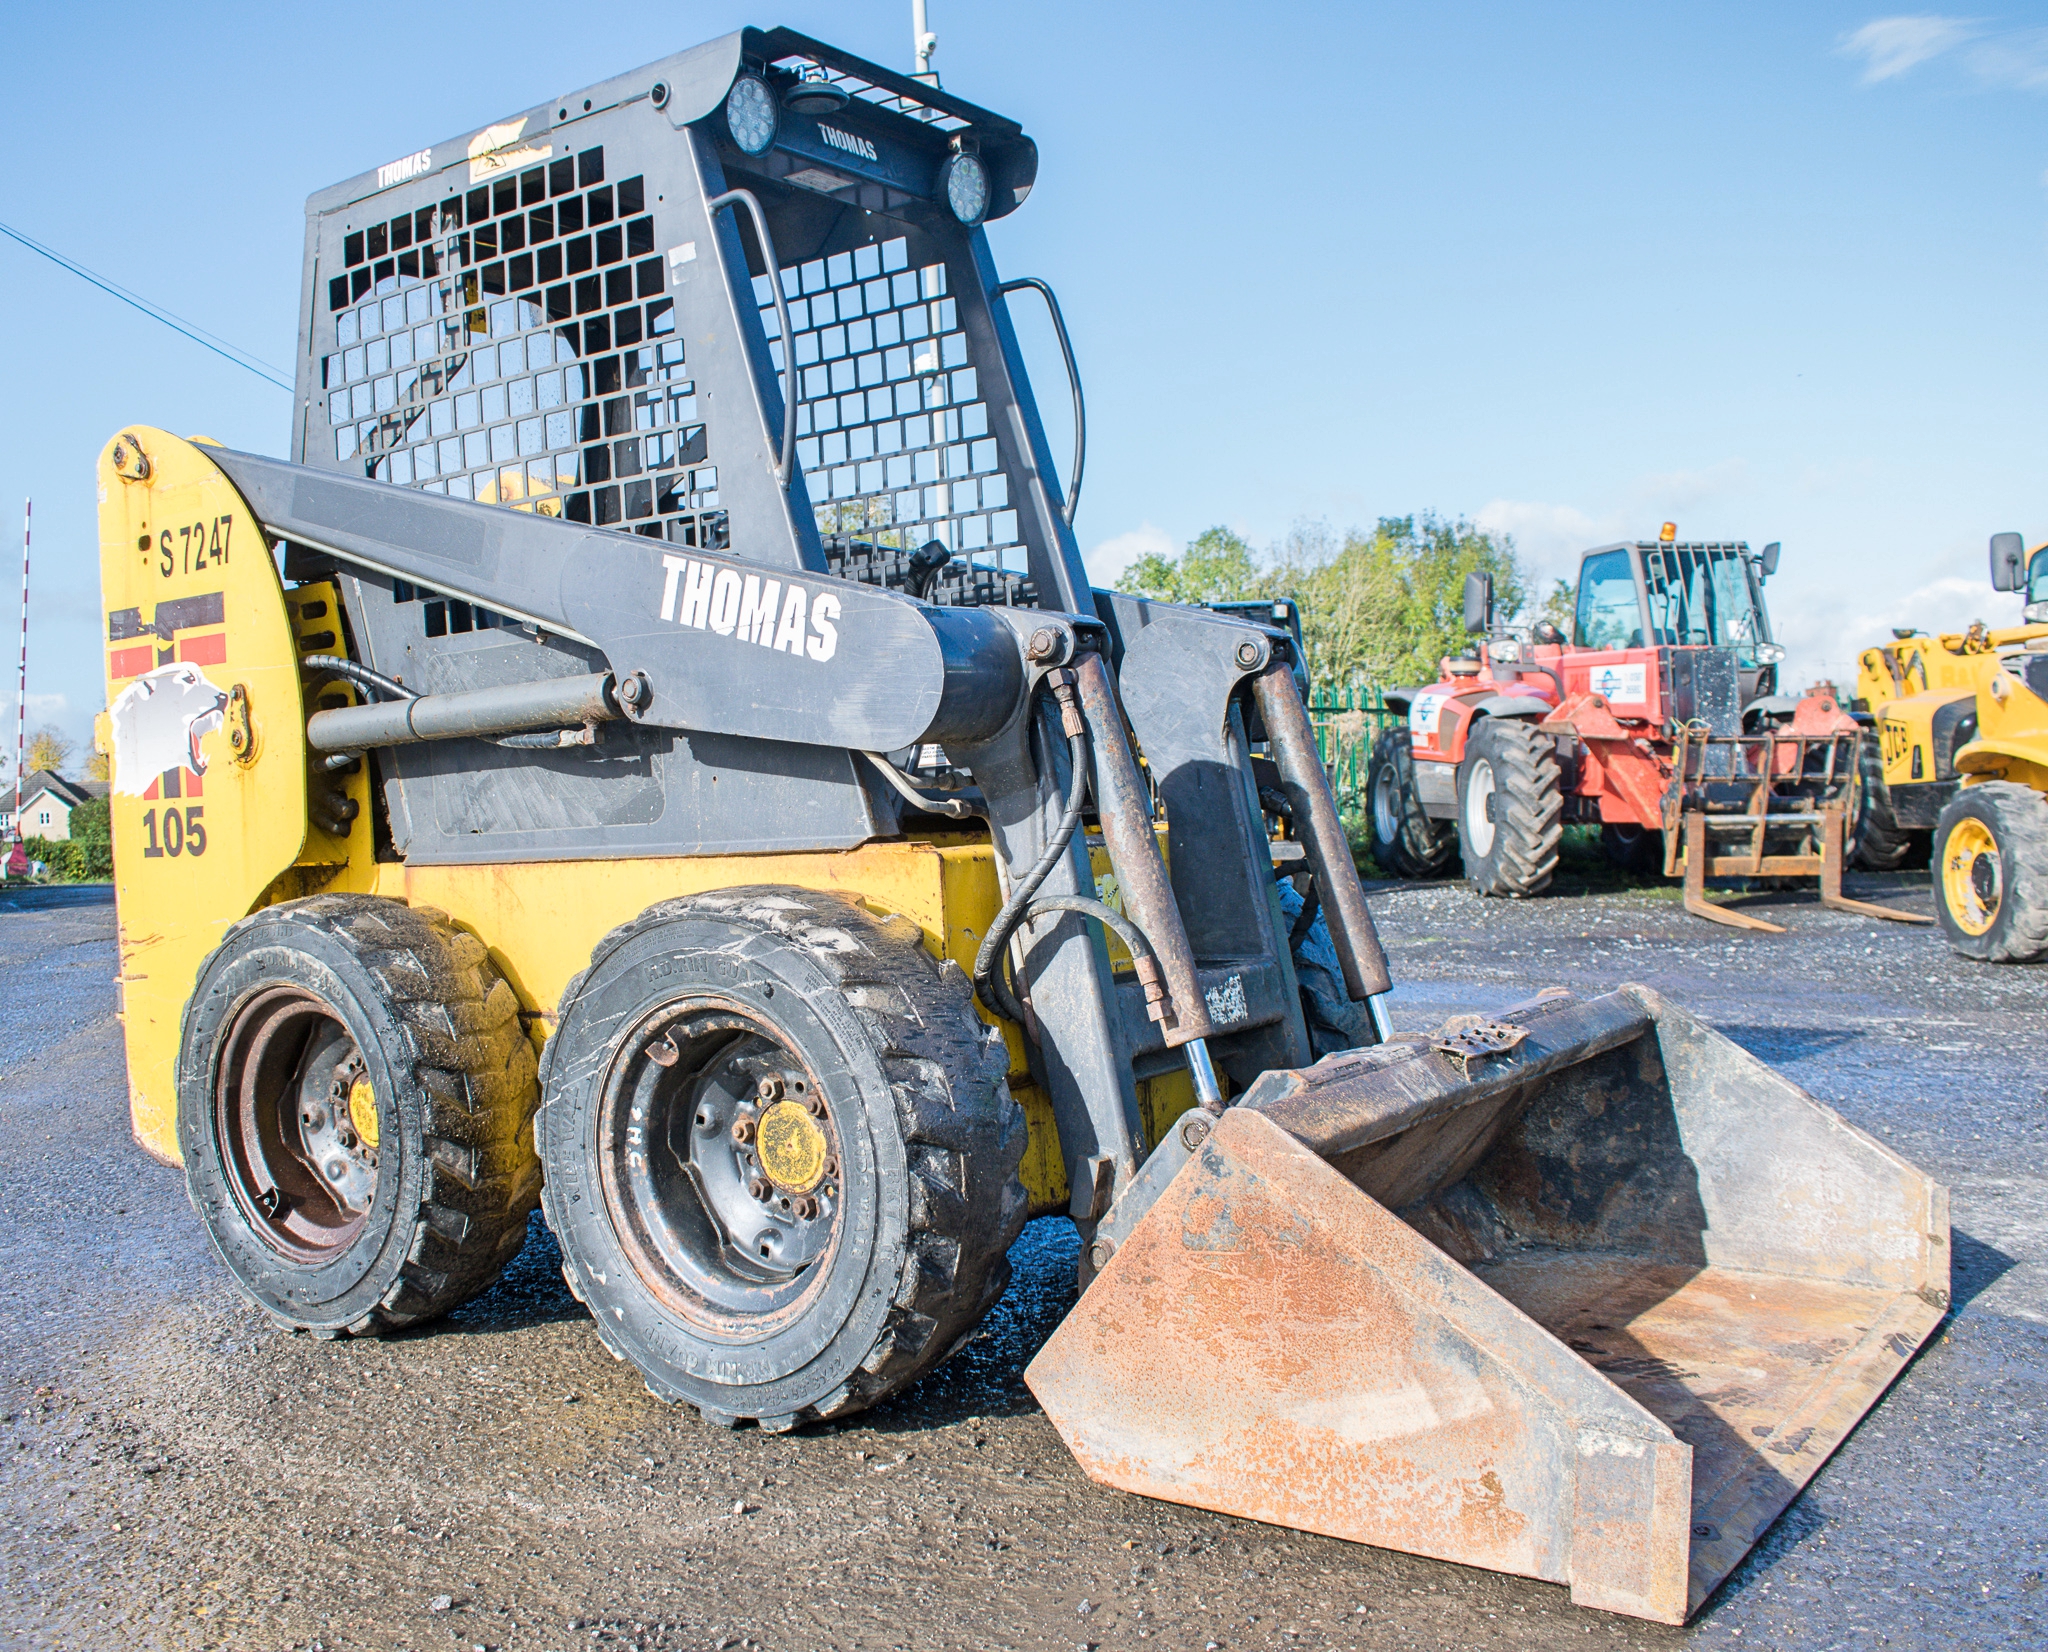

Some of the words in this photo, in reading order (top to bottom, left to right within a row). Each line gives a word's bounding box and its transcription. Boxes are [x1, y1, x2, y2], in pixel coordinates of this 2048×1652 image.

[817, 122, 878, 162] THOMAS
[378, 149, 431, 188] THOMAS
[660, 554, 842, 663] THOMAS
[1885, 724, 1908, 766] JCB
[143, 805, 207, 858] 105
